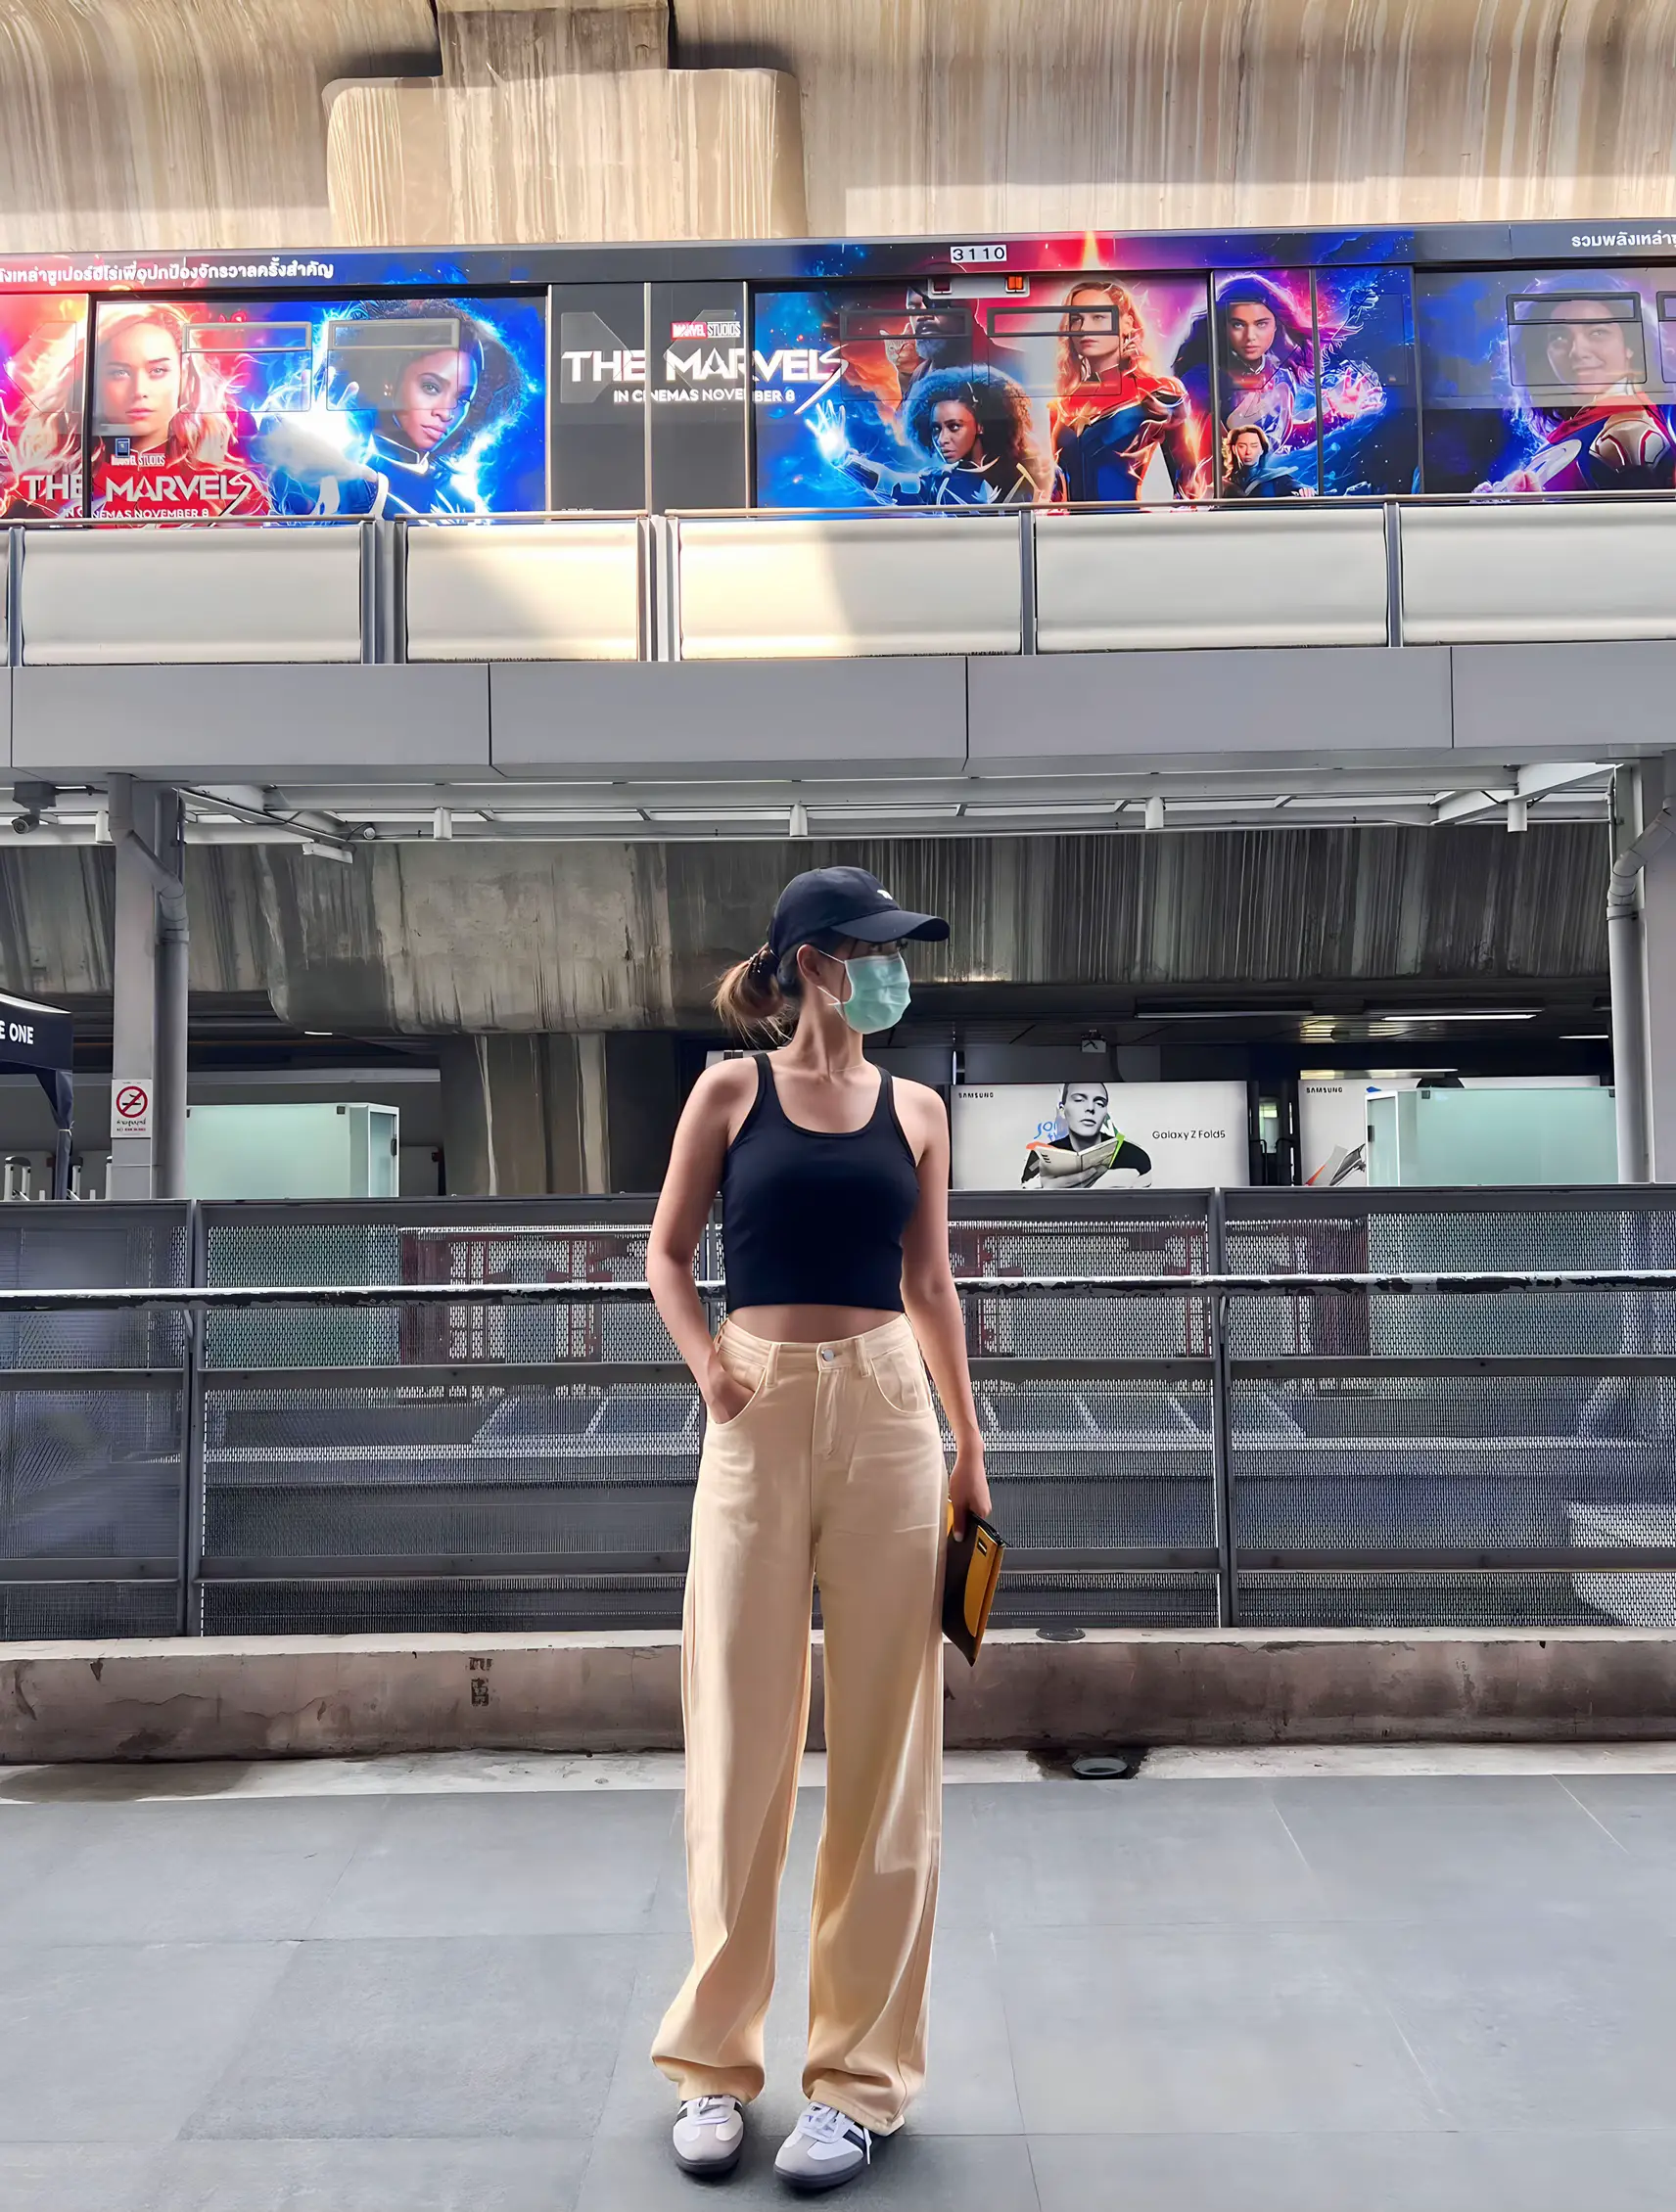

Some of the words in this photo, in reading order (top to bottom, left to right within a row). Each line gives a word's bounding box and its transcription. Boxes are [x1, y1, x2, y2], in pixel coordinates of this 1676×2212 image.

[953, 247, 1004, 261] 3110
[672, 323, 707, 338] MARVEL
[707, 321, 741, 338] STUDIOS
[561, 348, 646, 382] THE
[613, 390, 629, 403] IN
[785, 390, 796, 402] 8
[22, 475, 82, 500] THE
[106, 474, 252, 517] MARVELS
[134, 509, 199, 518] NOVEMBER
[201, 509, 210, 518] 8
[9, 1023, 34, 1044] ONE
[1152, 1130, 1189, 1140] Galaxy
[1198, 1129, 1226, 1138] Fold5
